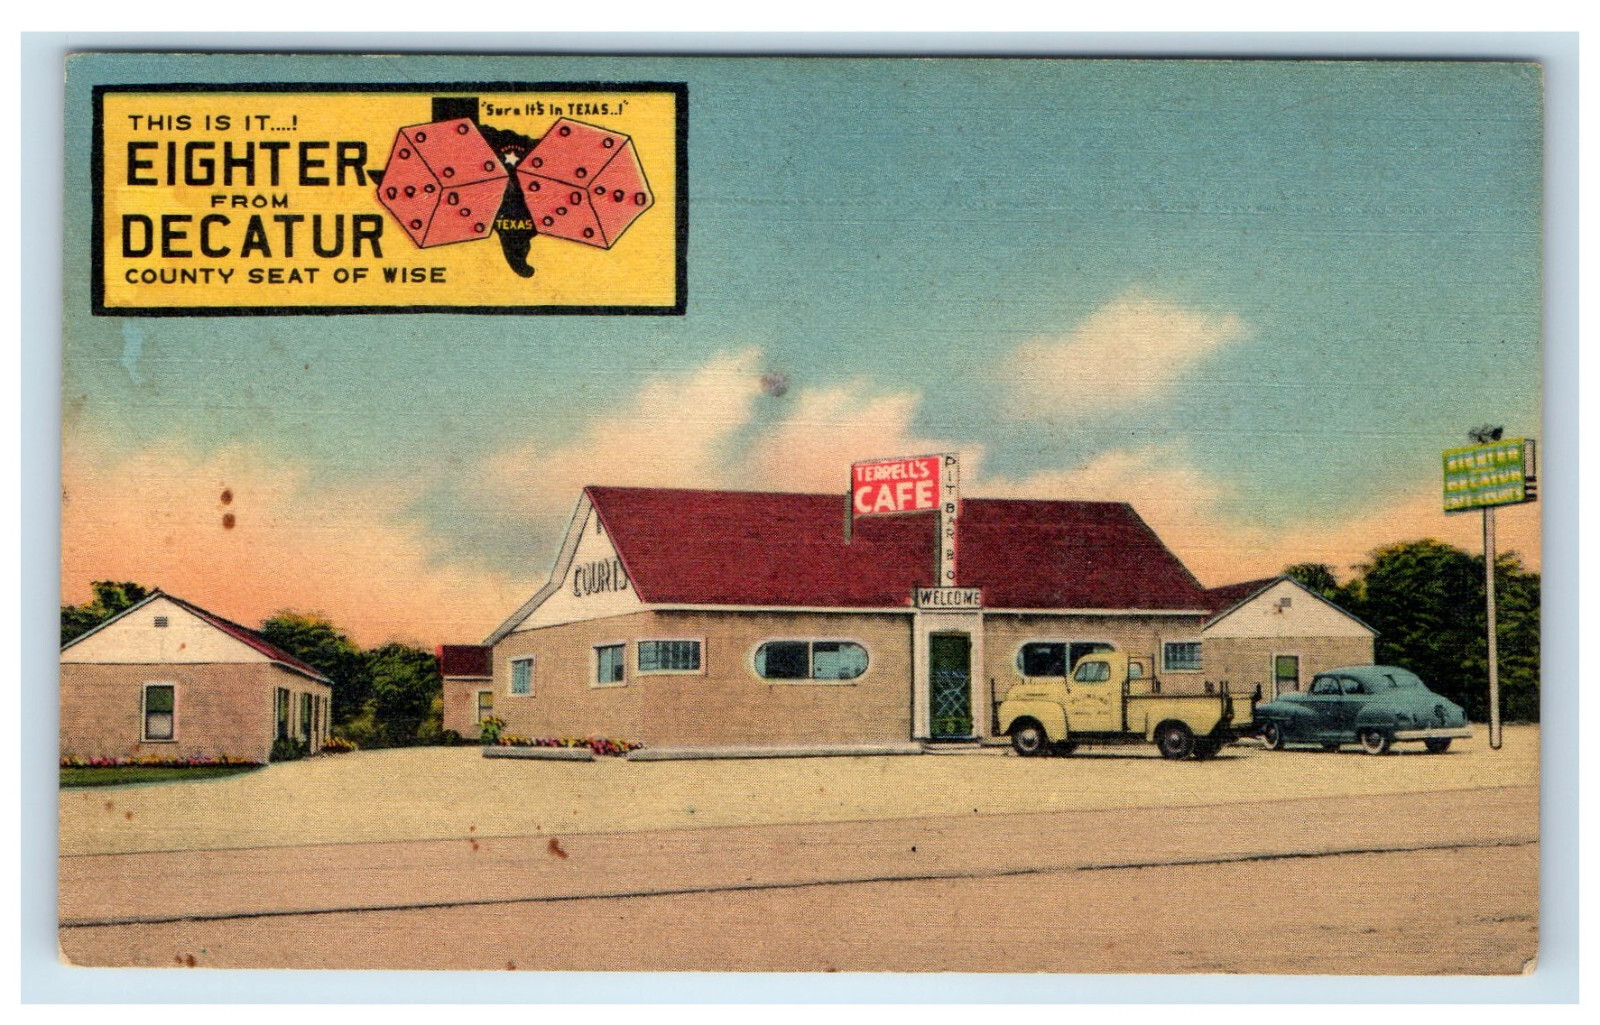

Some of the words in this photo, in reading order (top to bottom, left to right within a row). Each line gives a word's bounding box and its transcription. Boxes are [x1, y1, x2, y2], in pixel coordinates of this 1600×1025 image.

[128, 115, 192, 131] THIS
[205, 115, 231, 131] IS
[127, 141, 368, 186] EIGHTER
[210, 193, 289, 208] FROM
[496, 219, 533, 230] TEXAS
[121, 213, 384, 258] DECATUR
[125, 267, 234, 284] COUNTY
[248, 267, 320, 284] SEAT
[333, 267, 369, 284] OF
[382, 266, 447, 283] WISE
[856, 461, 930, 482] TERRELL'S
[854, 480, 933, 514] CAFE
[920, 590, 980, 606] WELCOME
